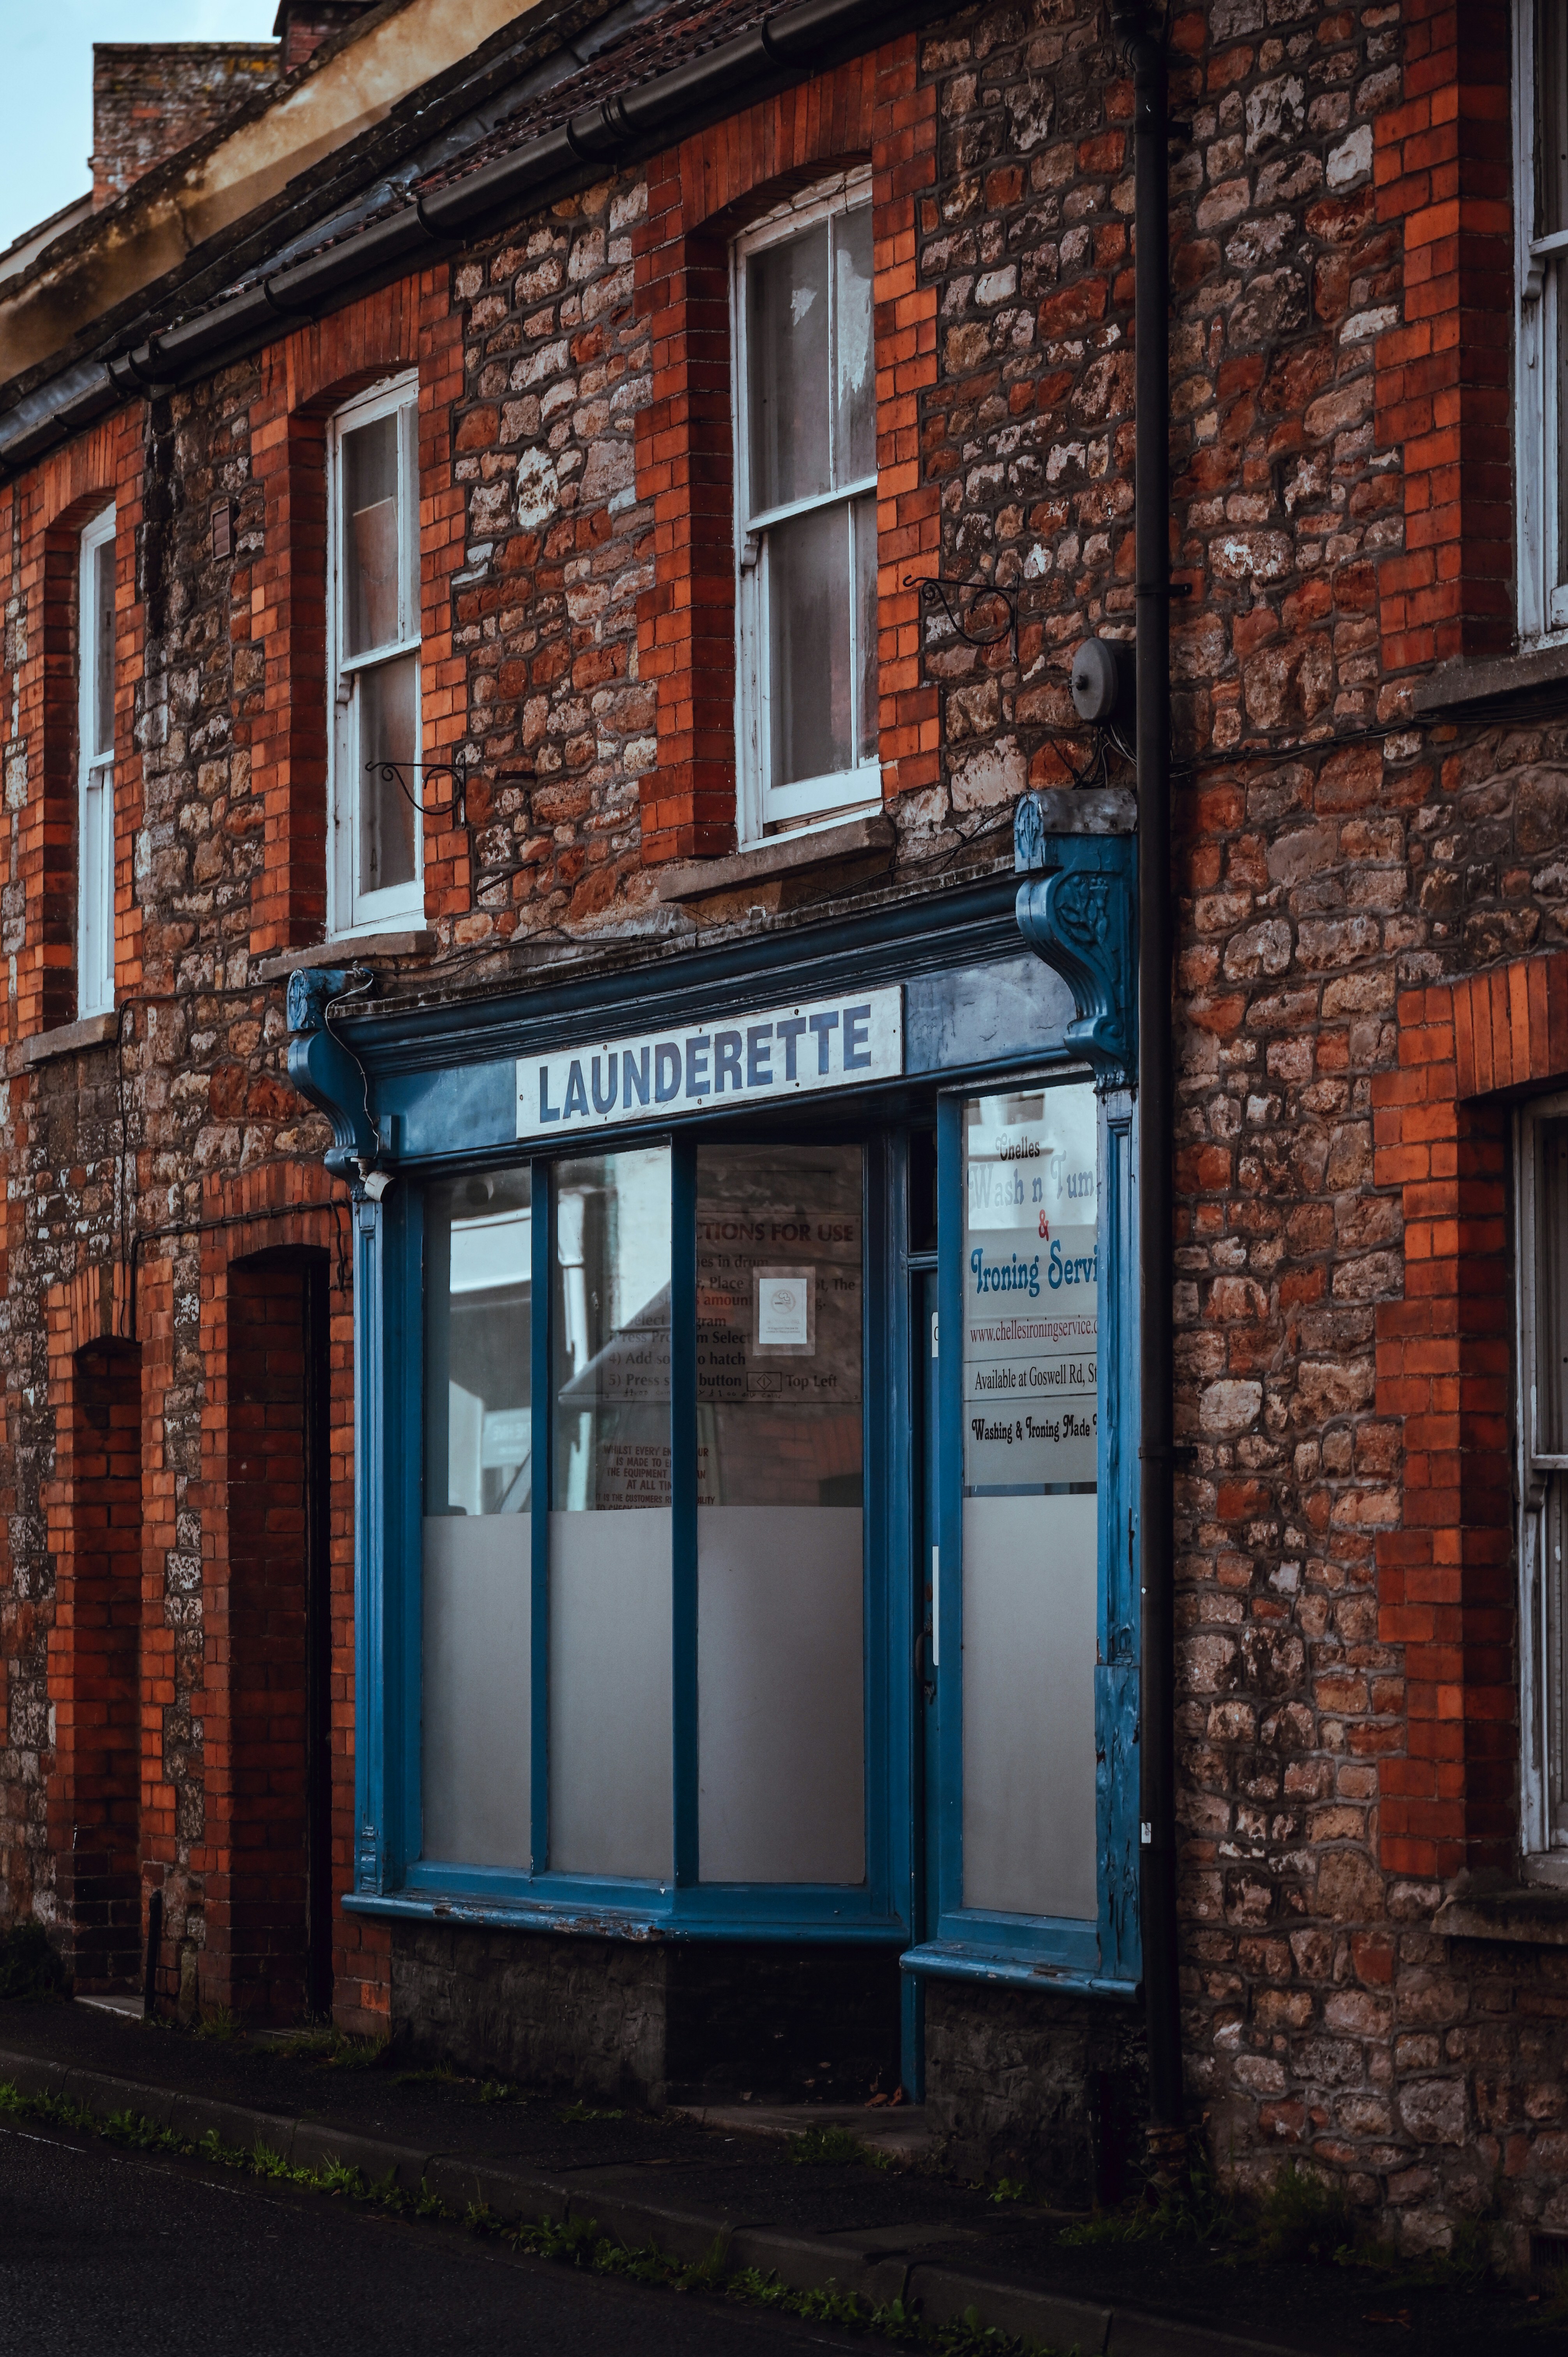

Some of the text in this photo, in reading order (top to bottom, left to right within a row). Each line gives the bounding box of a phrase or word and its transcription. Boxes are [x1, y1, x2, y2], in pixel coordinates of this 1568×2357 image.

[539, 1004, 871, 1123] LAUNDERETTE
[995, 1133, 1040, 1161] Chelles
[967, 1150, 1097, 1209] Wash n Tum
[771, 1223, 812, 1242] FOR
[818, 1224, 854, 1242] USE
[1038, 1209, 1049, 1242] &
[719, 1254, 730, 1267] in
[971, 1248, 1040, 1297] Ironing
[710, 1277, 744, 1290] Place
[832, 1278, 855, 1291] The
[626, 1351, 652, 1364] Add
[710, 1352, 746, 1365] hatch
[626, 1373, 660, 1386] Press
[699, 1373, 741, 1386] button
[786, 1375, 809, 1391] Top
[814, 1374, 838, 1387] Left
[975, 1368, 1016, 1390] Available
[1018, 1371, 1027, 1387] at
[1029, 1364, 1066, 1386] Goswell
[1069, 1363, 1085, 1387] Rd,
[971, 1418, 1013, 1444] Washing
[1016, 1420, 1022, 1441] &
[1026, 1416, 1060, 1443] Ironing
[1063, 1414, 1090, 1438] Made
[604, 1445, 632, 1455] WHILST
[635, 1446, 660, 1456] EVERY
[616, 1457, 623, 1466] IS
[627, 1458, 648, 1467] MADE
[652, 1458, 661, 1467] TO
[607, 1467, 667, 1479] THE EQUIPMENT
[627, 1479, 637, 1489] AT
[639, 1480, 655, 1490] ALL
[625, 1494, 662, 1504] CUSTOMERS
